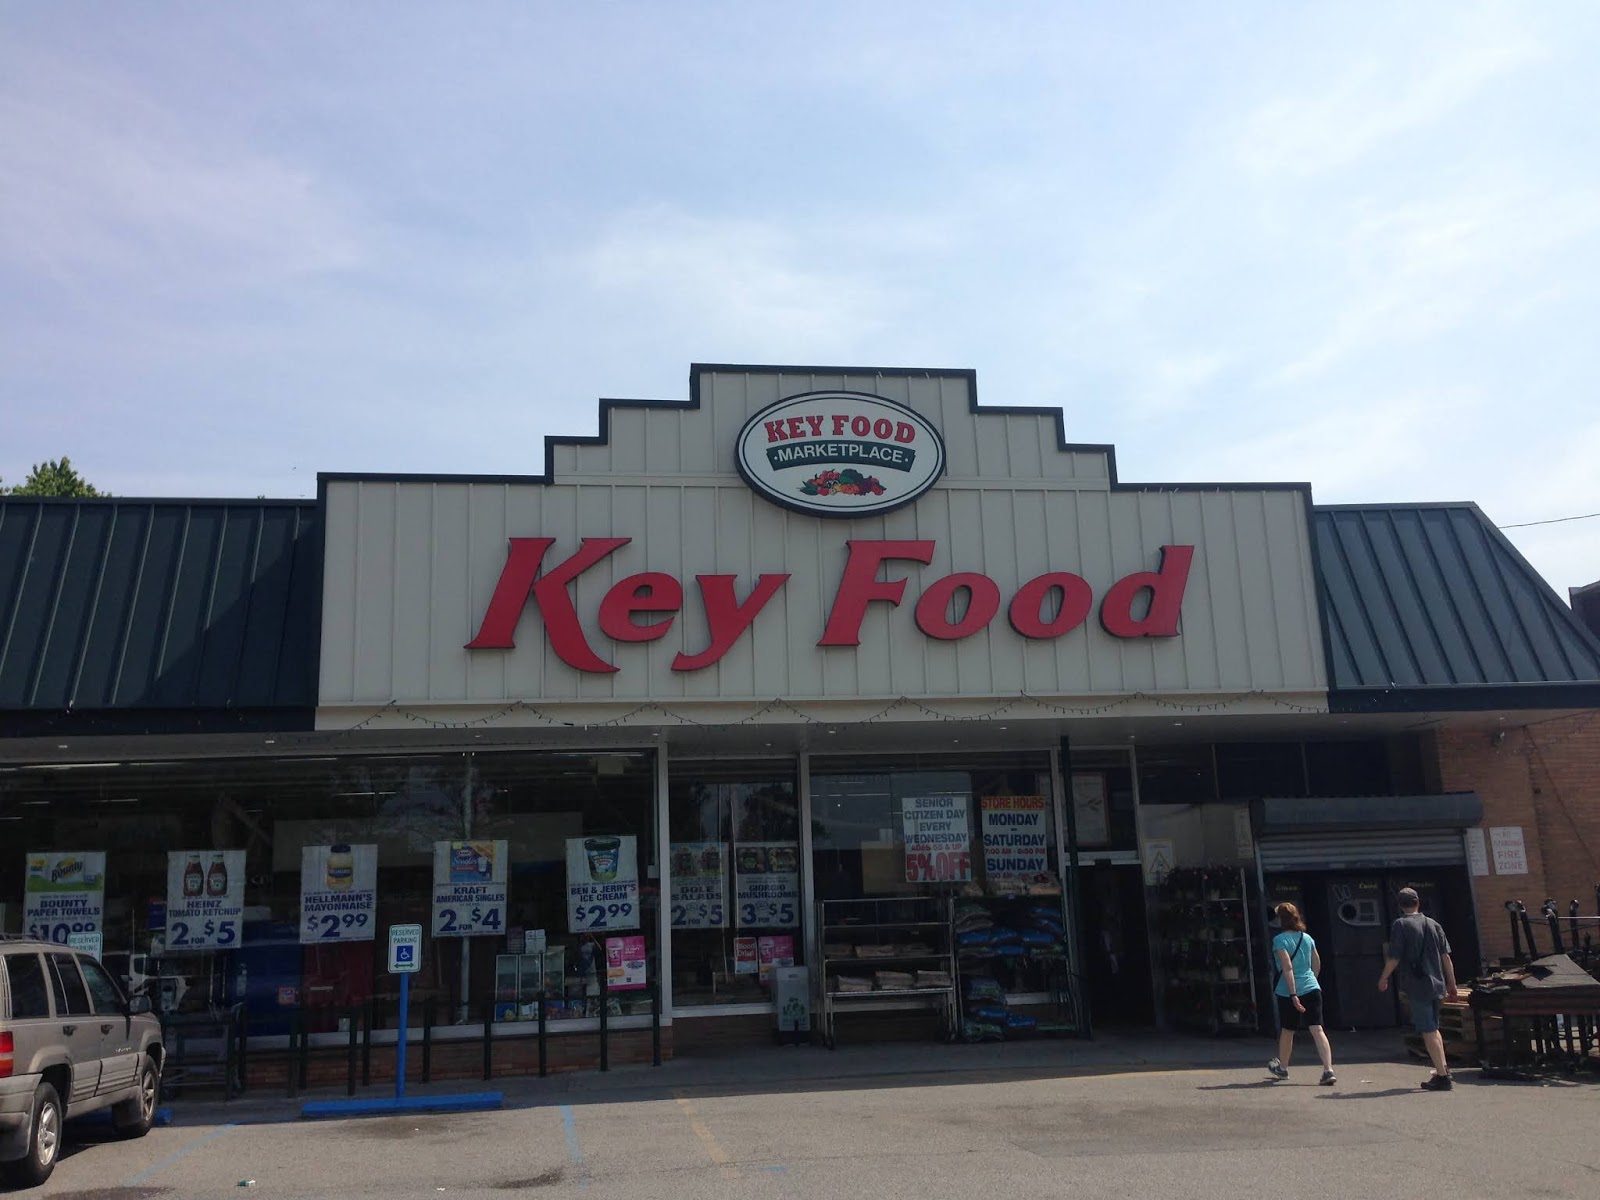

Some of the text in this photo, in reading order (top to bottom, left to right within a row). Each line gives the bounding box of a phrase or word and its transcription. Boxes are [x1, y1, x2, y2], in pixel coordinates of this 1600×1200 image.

[764, 415, 916, 443] KEY FOOD
[778, 443, 904, 463] MARKETPLACE
[464, 537, 1195, 673] Key Food
[915, 798, 953, 808] SENIOR
[981, 797, 1044, 808] STORE HOURS
[904, 809, 965, 820] CITIZEN DAY
[988, 813, 1039, 825] MONDAY
[919, 821, 951, 831] EVERY
[905, 833, 967, 844] WEDNESDAY
[984, 833, 1045, 846] SATURDAY
[1498, 850, 1521, 859] FIRE
[987, 858, 1045, 871] SUNDAY
[1499, 861, 1523, 870] ZONE
[453, 886, 488, 895] KRAFT
[571, 884, 636, 895] BEN & JERRY'S
[680, 885, 715, 893] DOLE
[749, 884, 786, 892] GIORGIO
[304, 893, 372, 904] HELLMANN'S
[436, 894, 505, 903] AMERICAN SINGLES
[596, 892, 628, 901] CREAM
[737, 891, 799, 899] MUSHROOMS
[40, 899, 88, 908] BOUNTY
[187, 900, 222, 909] HEINZ
[304, 901, 373, 912] MAYONNAISE
[28, 907, 100, 917] PAPER TOWELS
[168, 908, 241, 917] TOMATO KETCHUP
[670, 905, 687, 926] 2
[741, 903, 757, 925] 3
[439, 908, 457, 932] 2
[458, 923, 473, 931] FOR
[171, 921, 189, 945] 2
